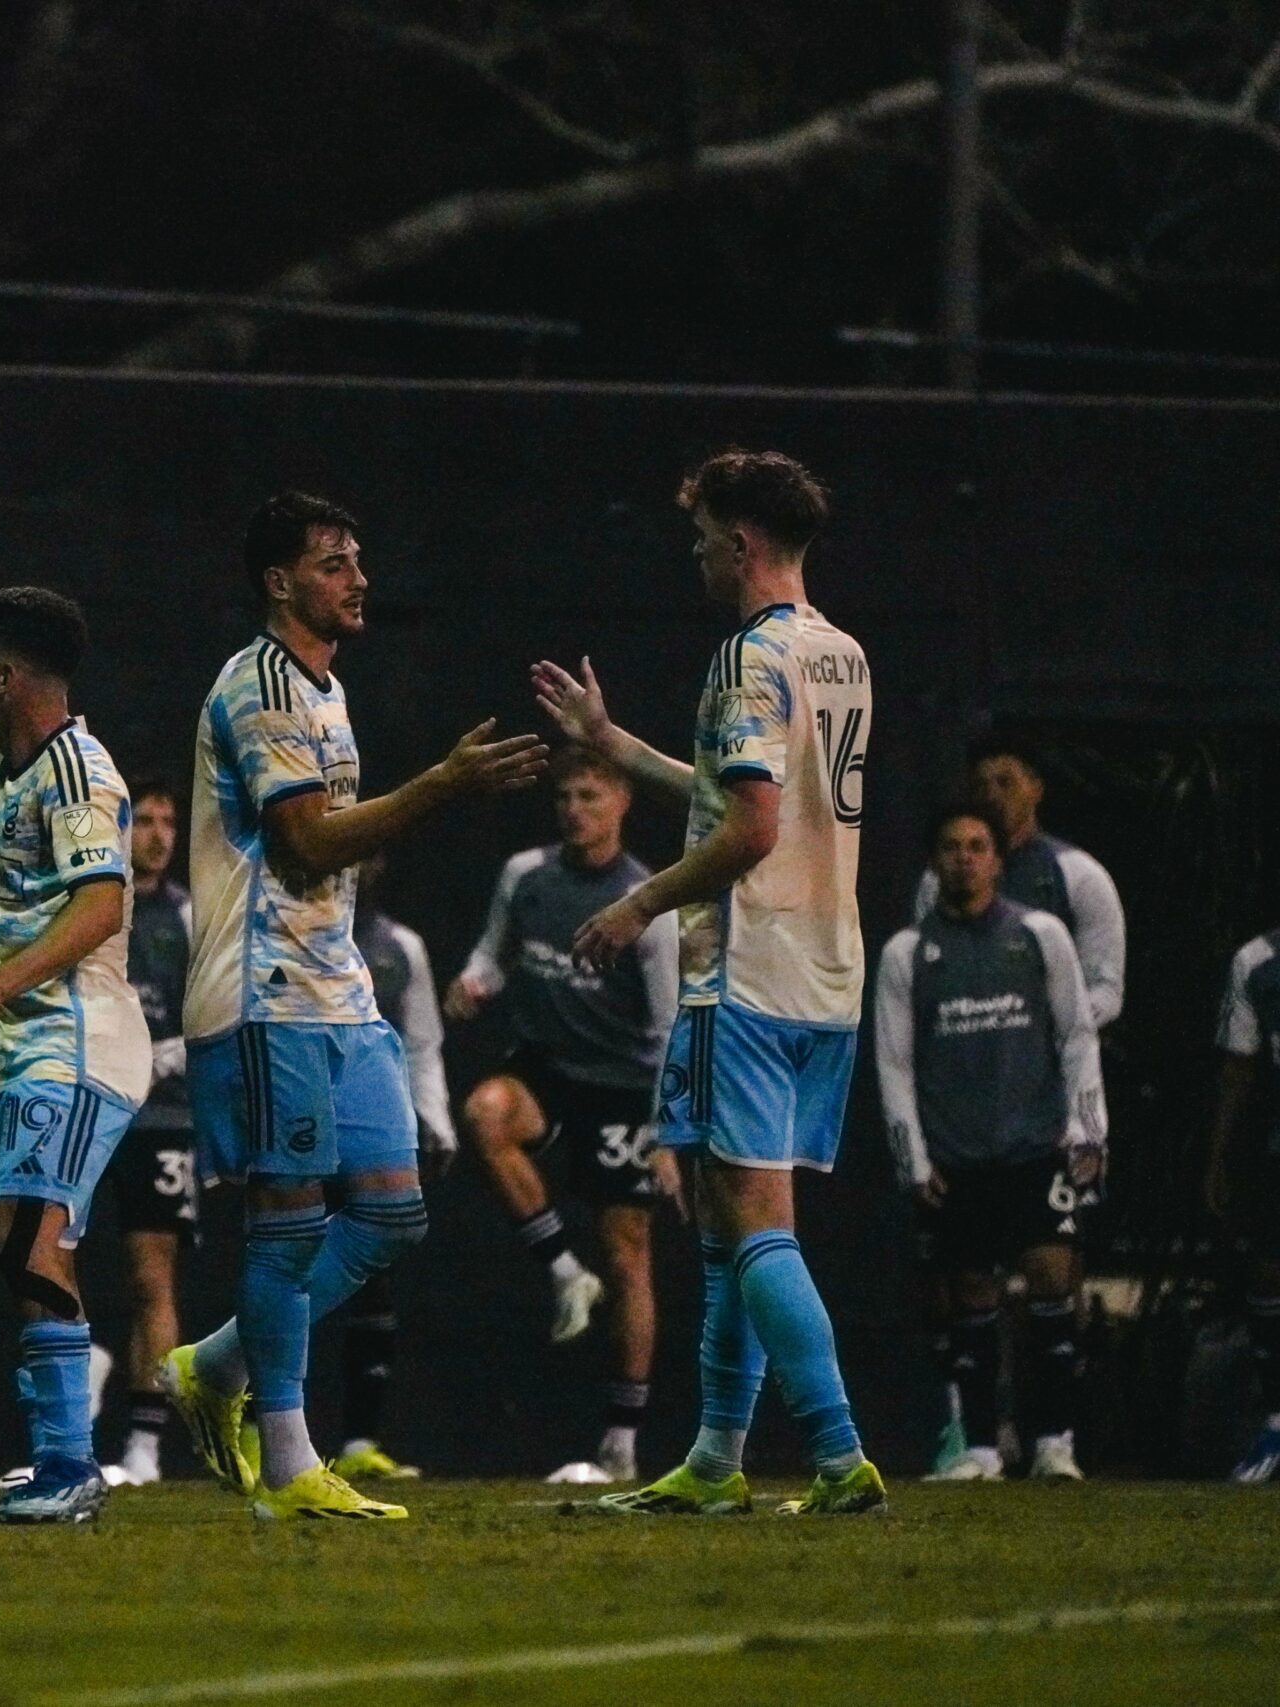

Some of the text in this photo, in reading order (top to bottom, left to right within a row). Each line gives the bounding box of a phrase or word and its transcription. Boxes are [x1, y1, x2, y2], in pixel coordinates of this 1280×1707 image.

[816, 708, 864, 829] 16
[65, 811, 81, 820] MLS
[80, 847, 107, 863] tv
[2, 1094, 63, 1154] 19
